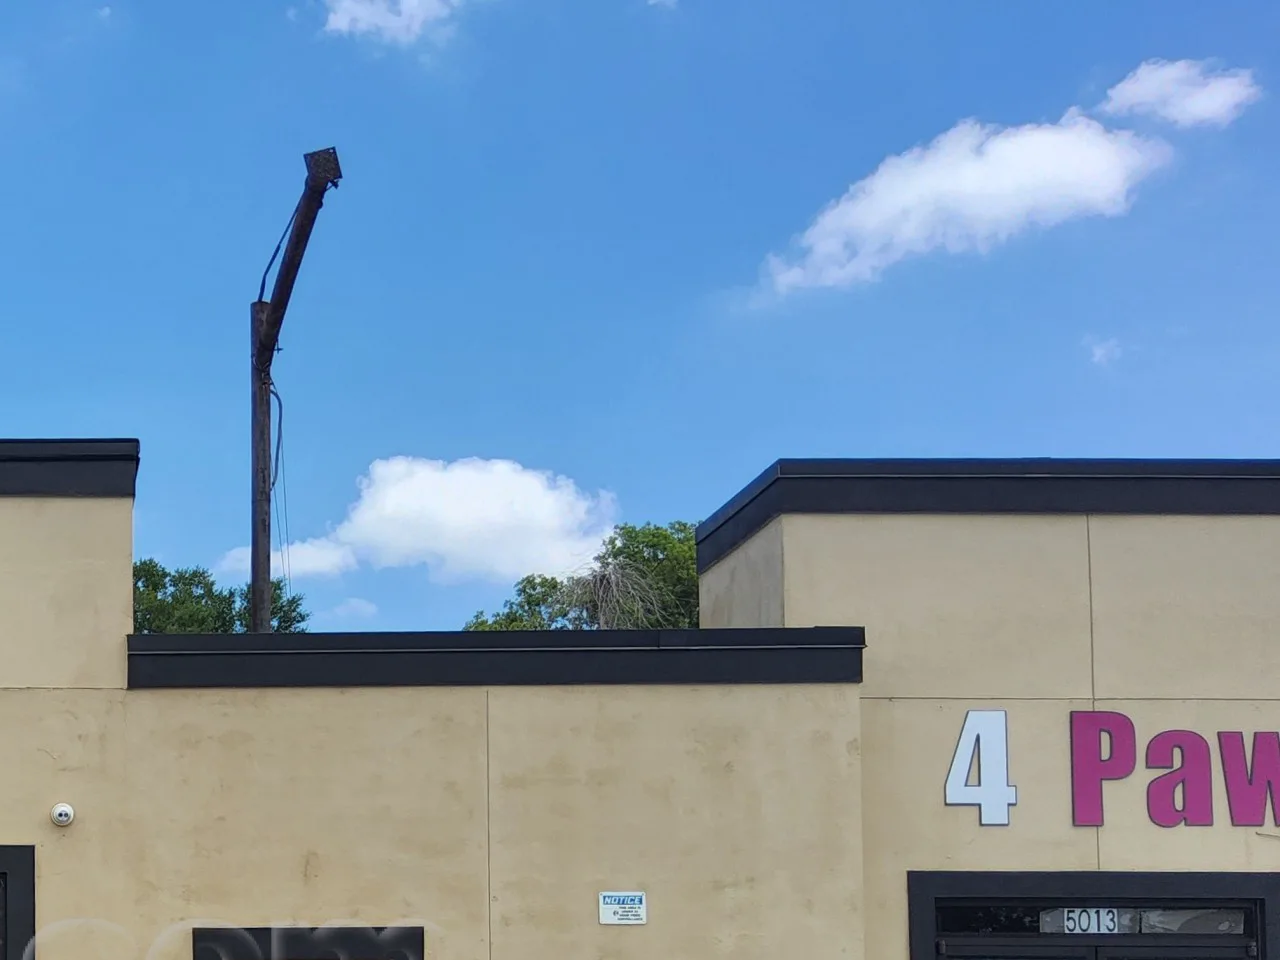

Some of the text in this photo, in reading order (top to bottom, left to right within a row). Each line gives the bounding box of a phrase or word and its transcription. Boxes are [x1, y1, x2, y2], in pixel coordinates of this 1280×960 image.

[944, 709, 1017, 826] 4
[604, 896, 641, 905] NOTICE
[1065, 909, 1117, 932] 5013
